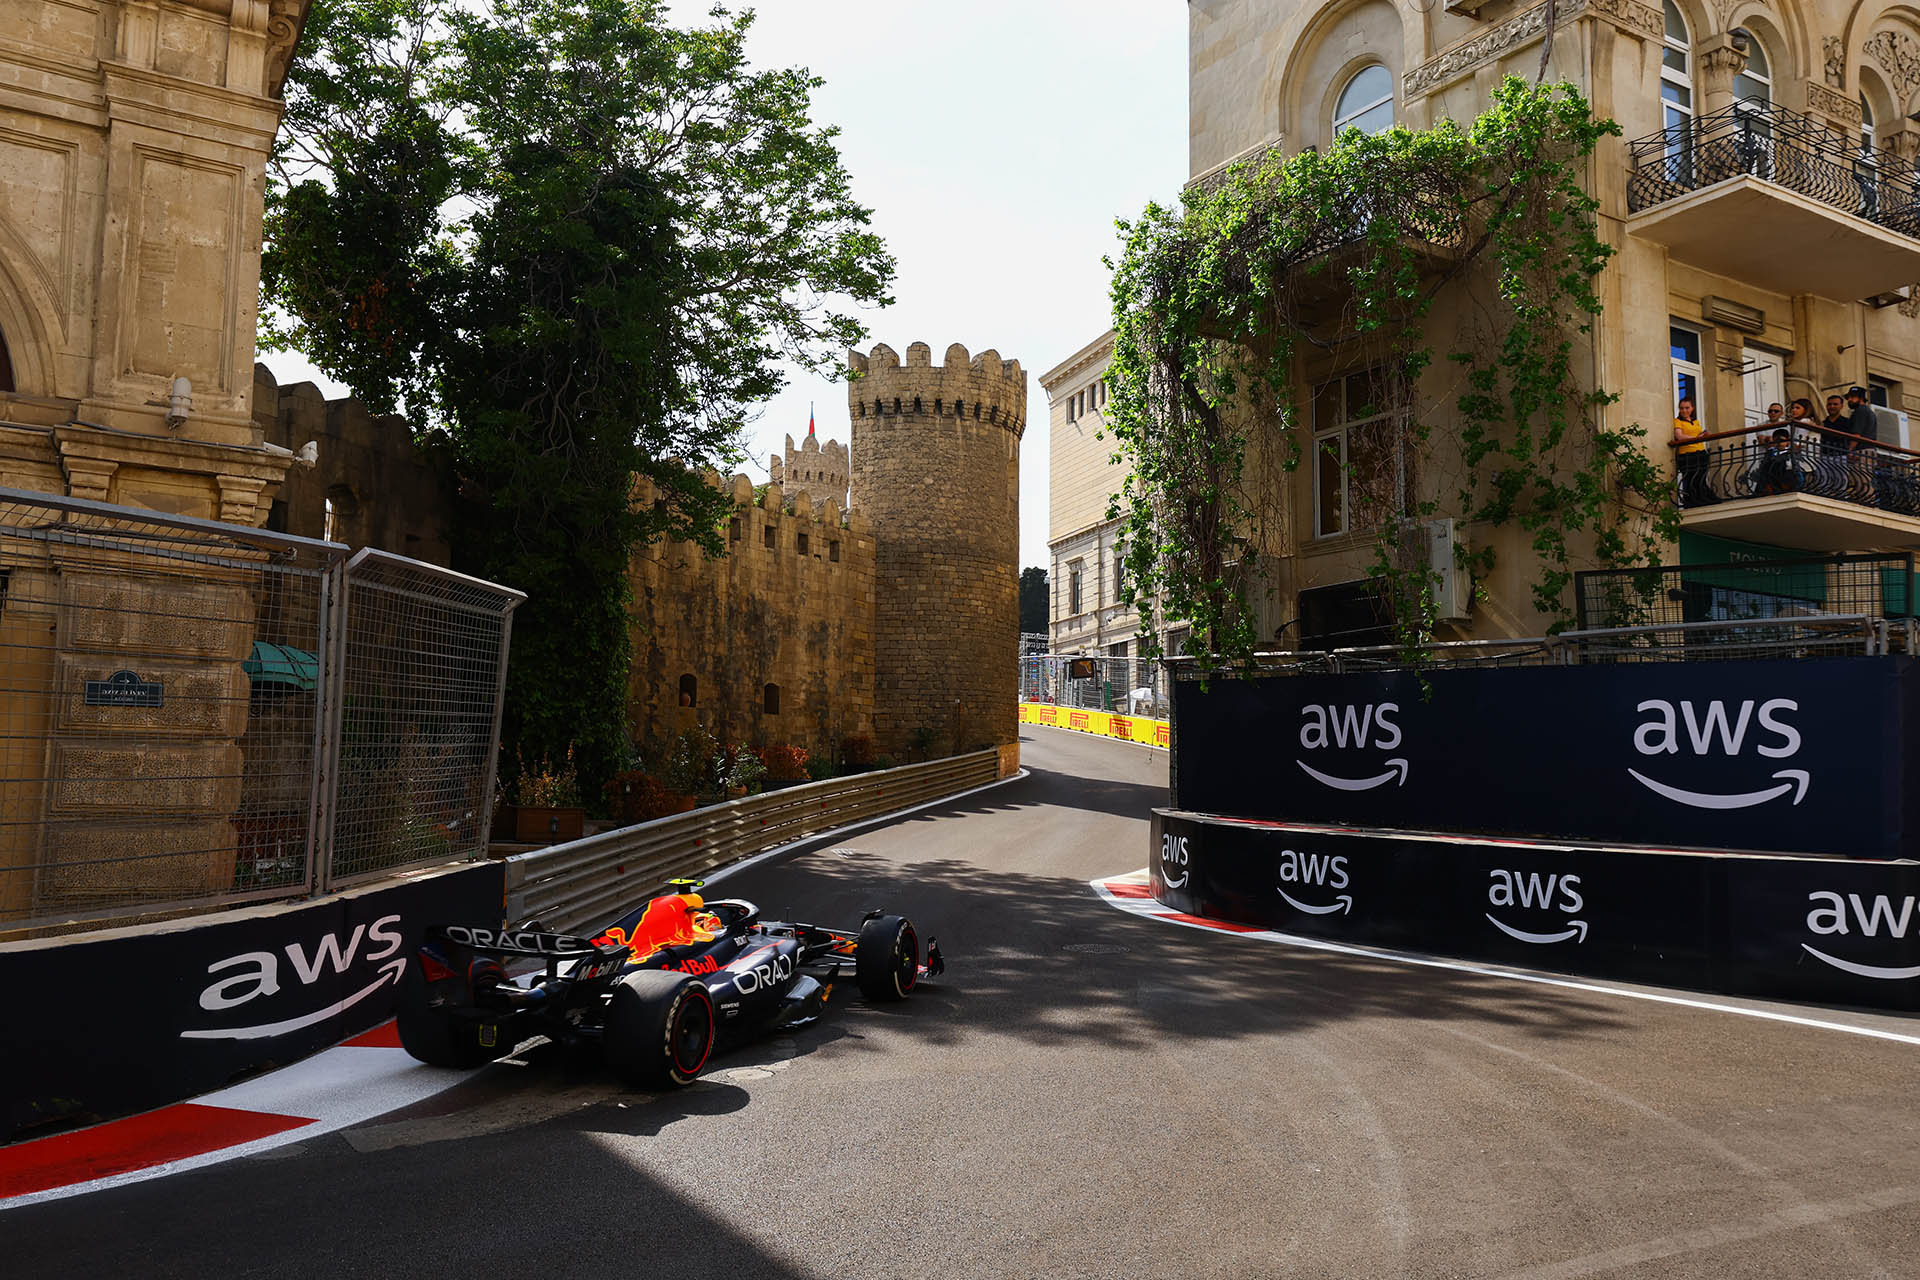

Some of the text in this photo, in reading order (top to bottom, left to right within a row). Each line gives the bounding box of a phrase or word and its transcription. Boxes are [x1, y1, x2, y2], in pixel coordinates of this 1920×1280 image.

[1040, 708, 1057, 724] PIRELLI
[1070, 712, 1089, 729] PIRELLI
[1109, 718, 1133, 737] PIRELLI
[1300, 703, 1401, 750] aws
[1634, 698, 1801, 758] aws
[1162, 833, 1188, 865] aws
[1279, 850, 1349, 889] aws
[1488, 869, 1583, 913] aws
[1807, 891, 1920, 938] aw
[446, 926, 577, 948] ORACLE
[200, 915, 402, 1010] aws
[576, 960, 614, 982] Mobil
[686, 954, 719, 976] Bull
